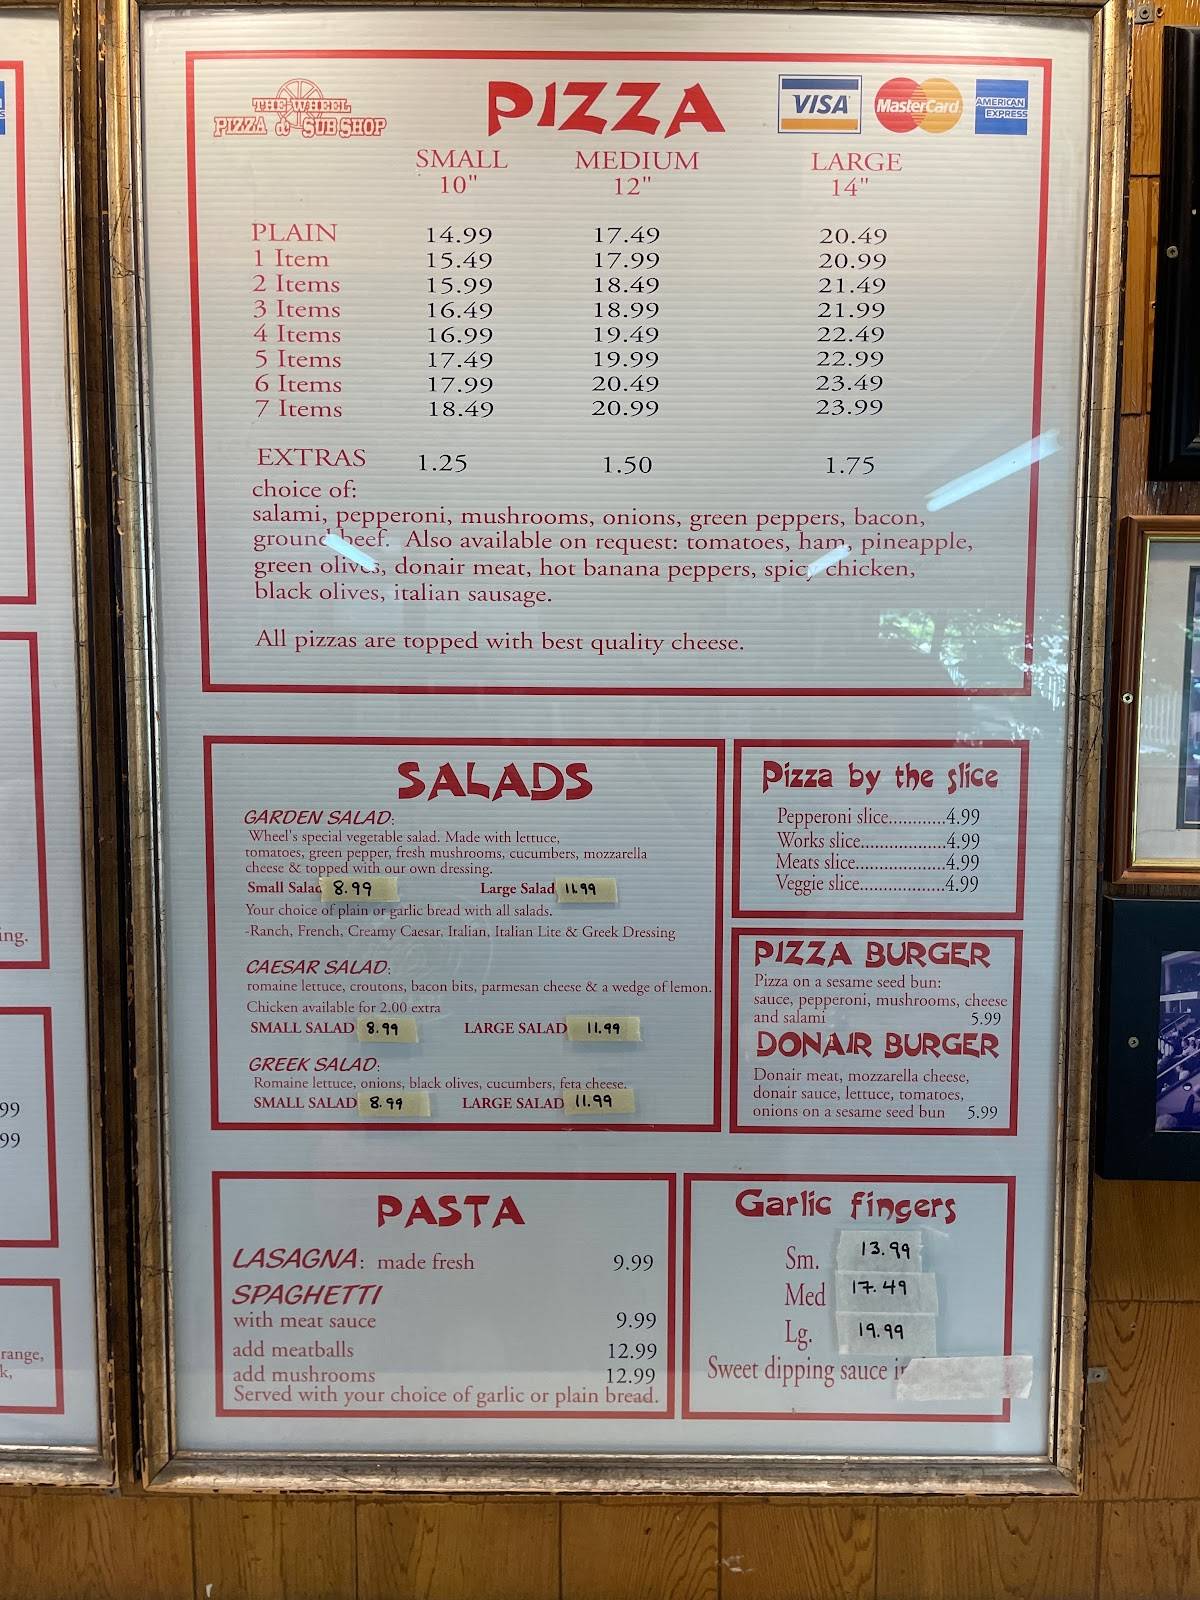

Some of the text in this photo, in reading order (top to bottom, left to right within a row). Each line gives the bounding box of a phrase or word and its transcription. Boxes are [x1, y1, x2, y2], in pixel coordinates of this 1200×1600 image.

[252, 98, 351, 113] THE WHEEL
[488, 80, 726, 139] PIZZA
[793, 94, 849, 114] VISA
[876, 98, 961, 114] MasterCard
[976, 97, 1024, 107] AMERICAN
[985, 109, 1028, 119] EXPRESS
[213, 116, 387, 138] PIZZA & SUB SHOP
[415, 149, 902, 171] SMALL MEDIUM LARGE
[251, 223, 888, 245] PLAIN 14.99 17.49 20.49
[255, 249, 887, 269] 1 Item 15.49 17.99 20.99
[253, 325, 885, 344] 4 Items 16.99 19.49 22.49
[256, 400, 883, 418] 7 Items 18.49 20.99 23.99
[257, 448, 875, 475] EXTRAS 1.25 1.50 1.75
[252, 479, 357, 498] choice of:
[252, 504, 926, 531] salami, pepperoni, mushrooms, onions, green peppers, bacon,
[255, 581, 552, 608] black olives, italian sausage.
[255, 629, 744, 656] All pizzas are topped with best quality cheese.
[397, 761, 593, 802] SALADS
[763, 760, 998, 795] Pizza by the slice
[244, 810, 395, 825] GARDEN SALAD:
[778, 807, 851, 829] Pepperoni
[250, 830, 560, 846] Wheel's special vegetable salad. Made with lettuce,
[246, 846, 647, 863] tomatoes, green pepper, fresh mushrooms, cucumbers, mozzarella
[248, 881, 284, 894] Small
[333, 880, 372, 896] 8.99
[481, 883, 555, 897] Large Salad
[565, 883, 596, 895] 11.99
[755, 941, 990, 968] PIZZA BURGER
[246, 960, 391, 975] CAESAR SALAD:
[754, 974, 941, 989] Pizza on a sesame seed bun:
[247, 1001, 440, 1013] Chicken available for 2.00 extra
[754, 994, 1008, 1009] sauce, pepperoni, mushrooms, cheese
[251, 1022, 354, 1033] SMALL SALAD
[366, 1021, 398, 1035] 8.99
[464, 1022, 567, 1034] LARGE SALAD
[587, 1022, 620, 1034] 11.99
[757, 1031, 999, 1059] DONAIR BURGER
[249, 1057, 380, 1072] GREEK SALAD:
[254, 1076, 627, 1090] Romaine lettuce, onions, black olives, cucumbers, feta cheese.
[754, 1068, 969, 1084] Donair meat, mozzarella cheese,
[377, 1194, 526, 1229] PASTA
[736, 1189, 956, 1224] Garlic fingers
[785, 1246, 819, 1270] Sm.
[861, 1241, 911, 1259] 13.99
[233, 1247, 654, 1272] LASAGNA: made fresh 9.99
[232, 1285, 383, 1306] SPAGHETTI
[785, 1320, 812, 1350] Lg.
[859, 1323, 904, 1340] 19.99
[233, 1342, 657, 1360] add meatballs 12.99
[708, 1355, 759, 1380] Sweet
[765, 1356, 834, 1387] dipping
[840, 1363, 887, 1380] sauce
